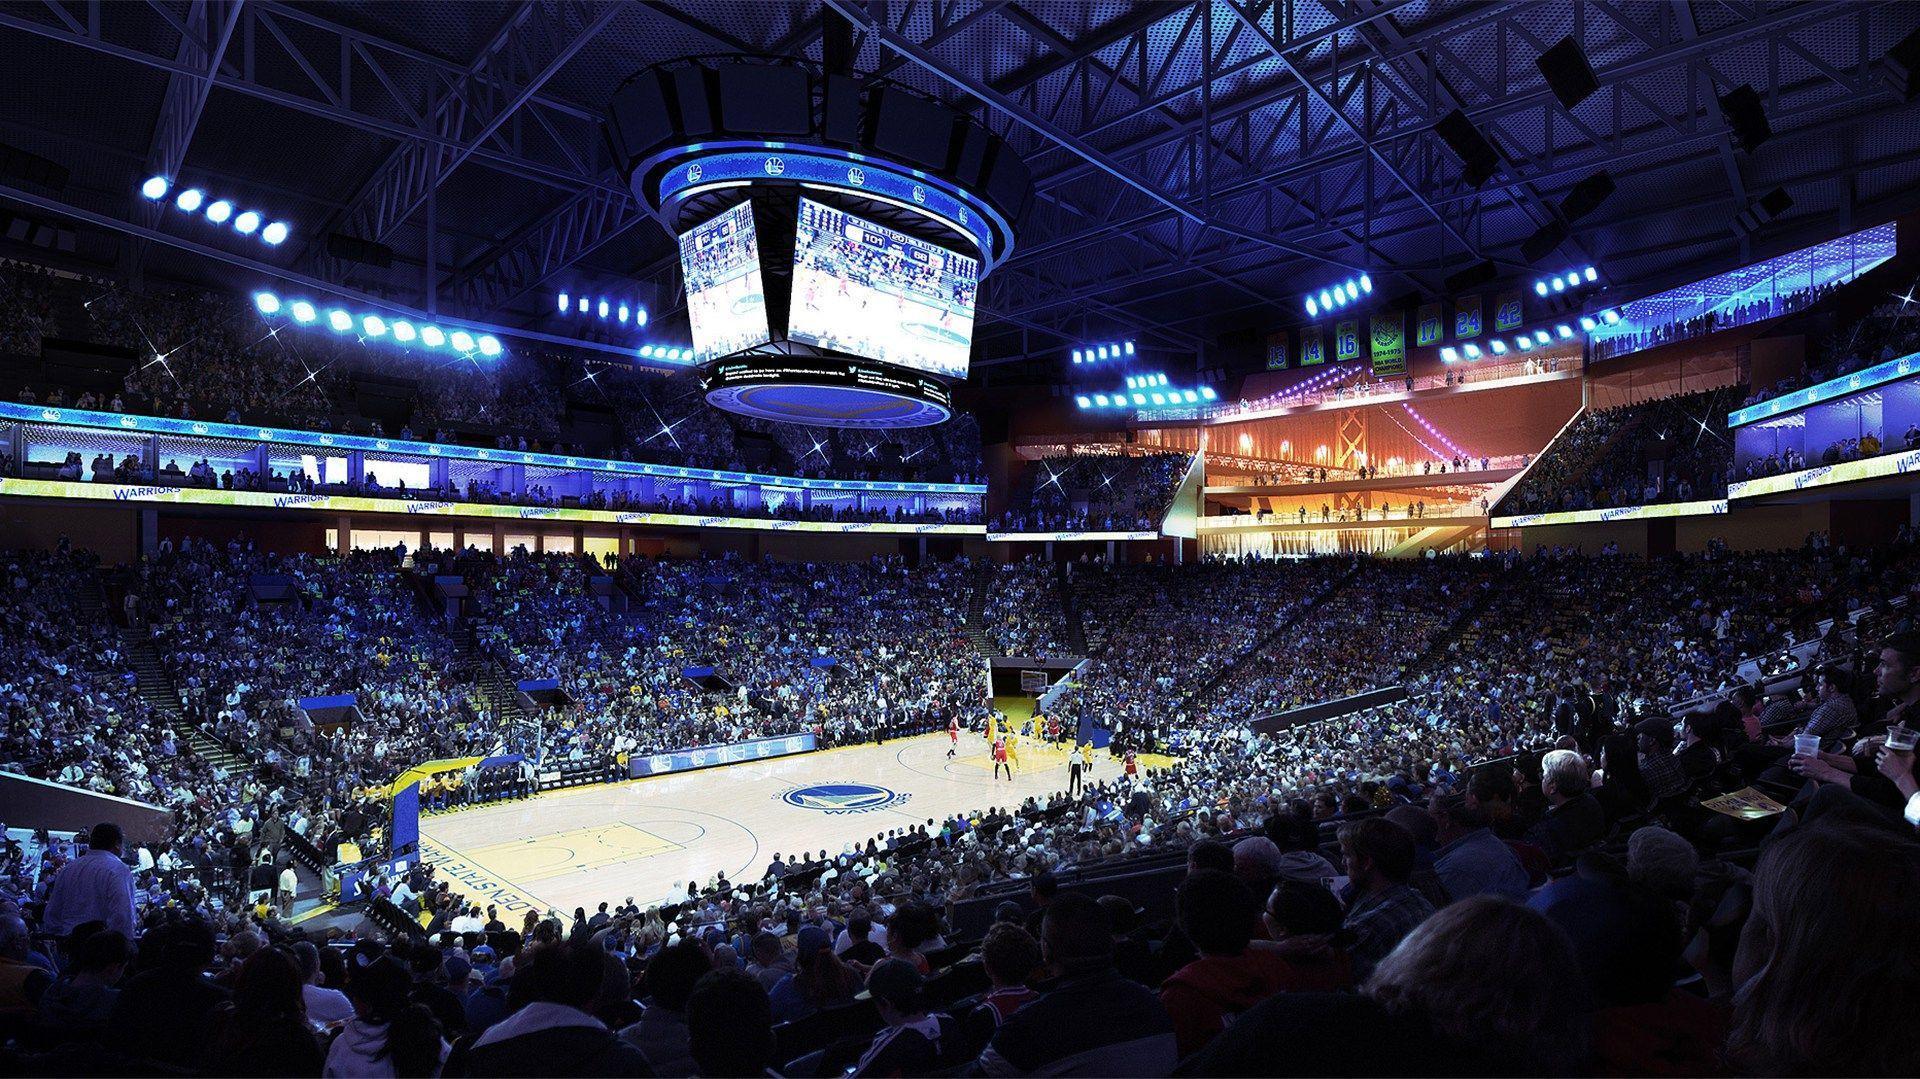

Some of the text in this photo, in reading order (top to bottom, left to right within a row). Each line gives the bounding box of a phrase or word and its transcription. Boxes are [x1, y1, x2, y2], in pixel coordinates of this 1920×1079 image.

[864, 233, 883, 246] 101
[1457, 310, 1480, 335] 24
[1497, 301, 1521, 325] 42
[1421, 317, 1438, 342] 17
[1303, 340, 1320, 361] 14
[1338, 333, 1356, 355] 16
[1269, 345, 1286, 366] 13
[1794, 465, 1832, 489] WARRIORS
[113, 486, 181, 500] WARRIORS
[273, 495, 329, 509] WARRIORS
[407, 501, 454, 514] WARRIORS
[1600, 506, 1642, 522] WARRIORS
[1511, 514, 1545, 527] WARRIORS
[442, 863, 497, 892] STATE
